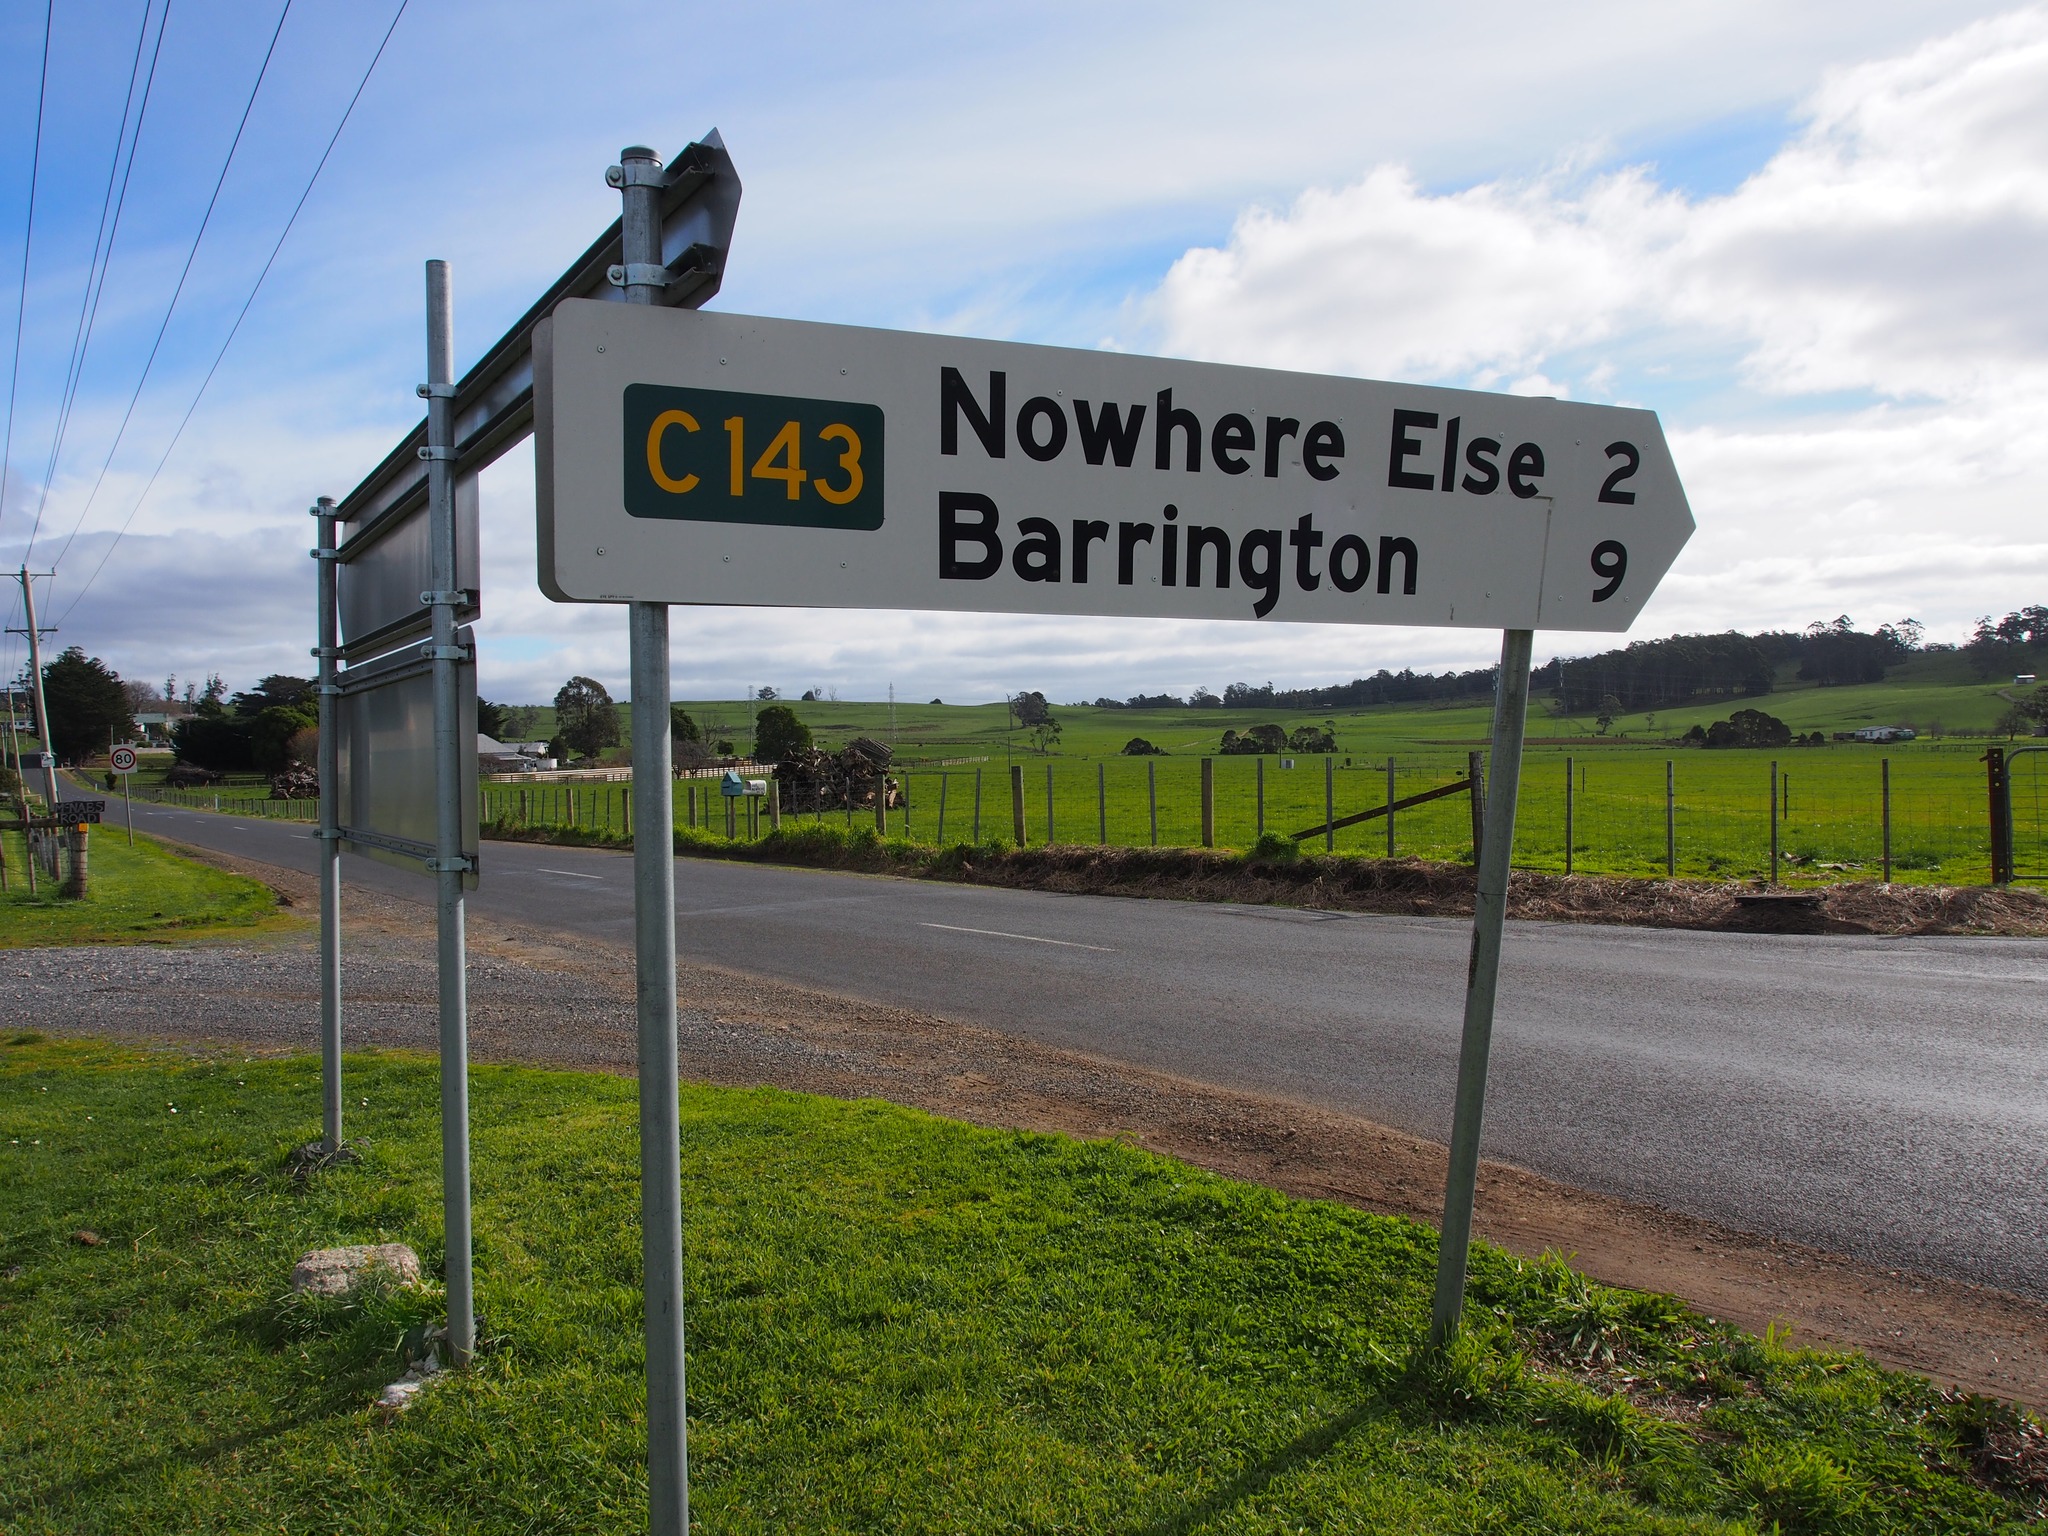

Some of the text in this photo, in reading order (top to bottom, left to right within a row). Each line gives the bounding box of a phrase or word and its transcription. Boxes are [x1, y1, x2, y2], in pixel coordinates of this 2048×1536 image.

[940, 366, 1640, 506] Nowhere Else 2
[938, 490, 1628, 619] Barrington 9
[115, 754, 132, 764] 80
[61, 813, 96, 823] ROAD
